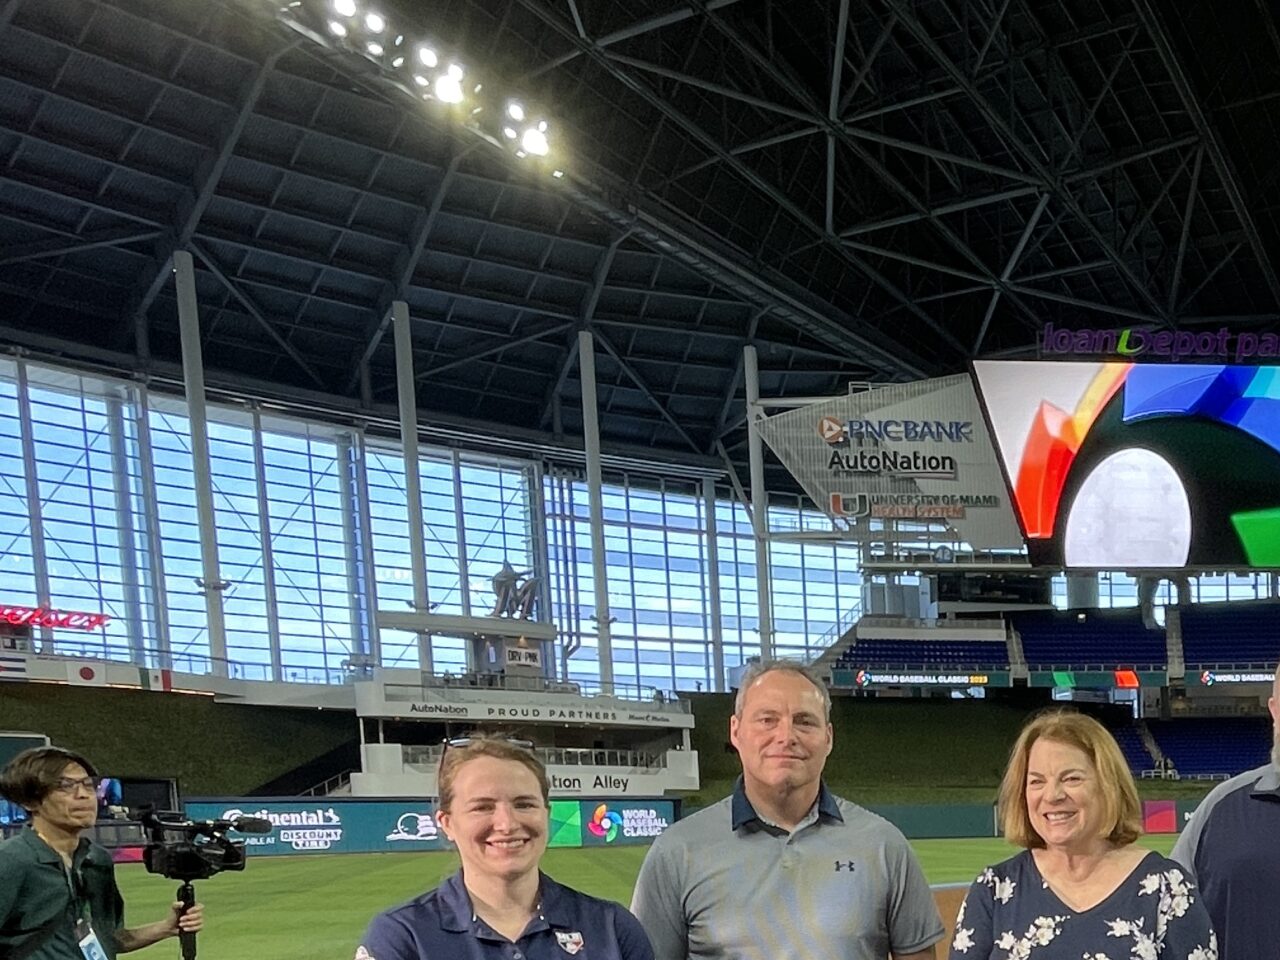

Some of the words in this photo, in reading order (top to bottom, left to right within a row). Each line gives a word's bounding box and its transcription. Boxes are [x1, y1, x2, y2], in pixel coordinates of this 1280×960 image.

[1043, 322, 1231, 361] loanDepot
[828, 451, 955, 471] AutoNation
[960, 495, 997, 505] MIAMI
[872, 675, 899, 683] WORLD
[899, 675, 937, 683] BASEBALL
[410, 703, 468, 716] AutoNation
[488, 708, 540, 718] PROUD
[549, 709, 617, 721] PARTNERS
[593, 775, 629, 792] Alley
[622, 809, 656, 819] WORLD
[623, 818, 668, 828] BASEBALL
[283, 831, 340, 841] DISCOUNT
[623, 827, 662, 837] CLASSIC
